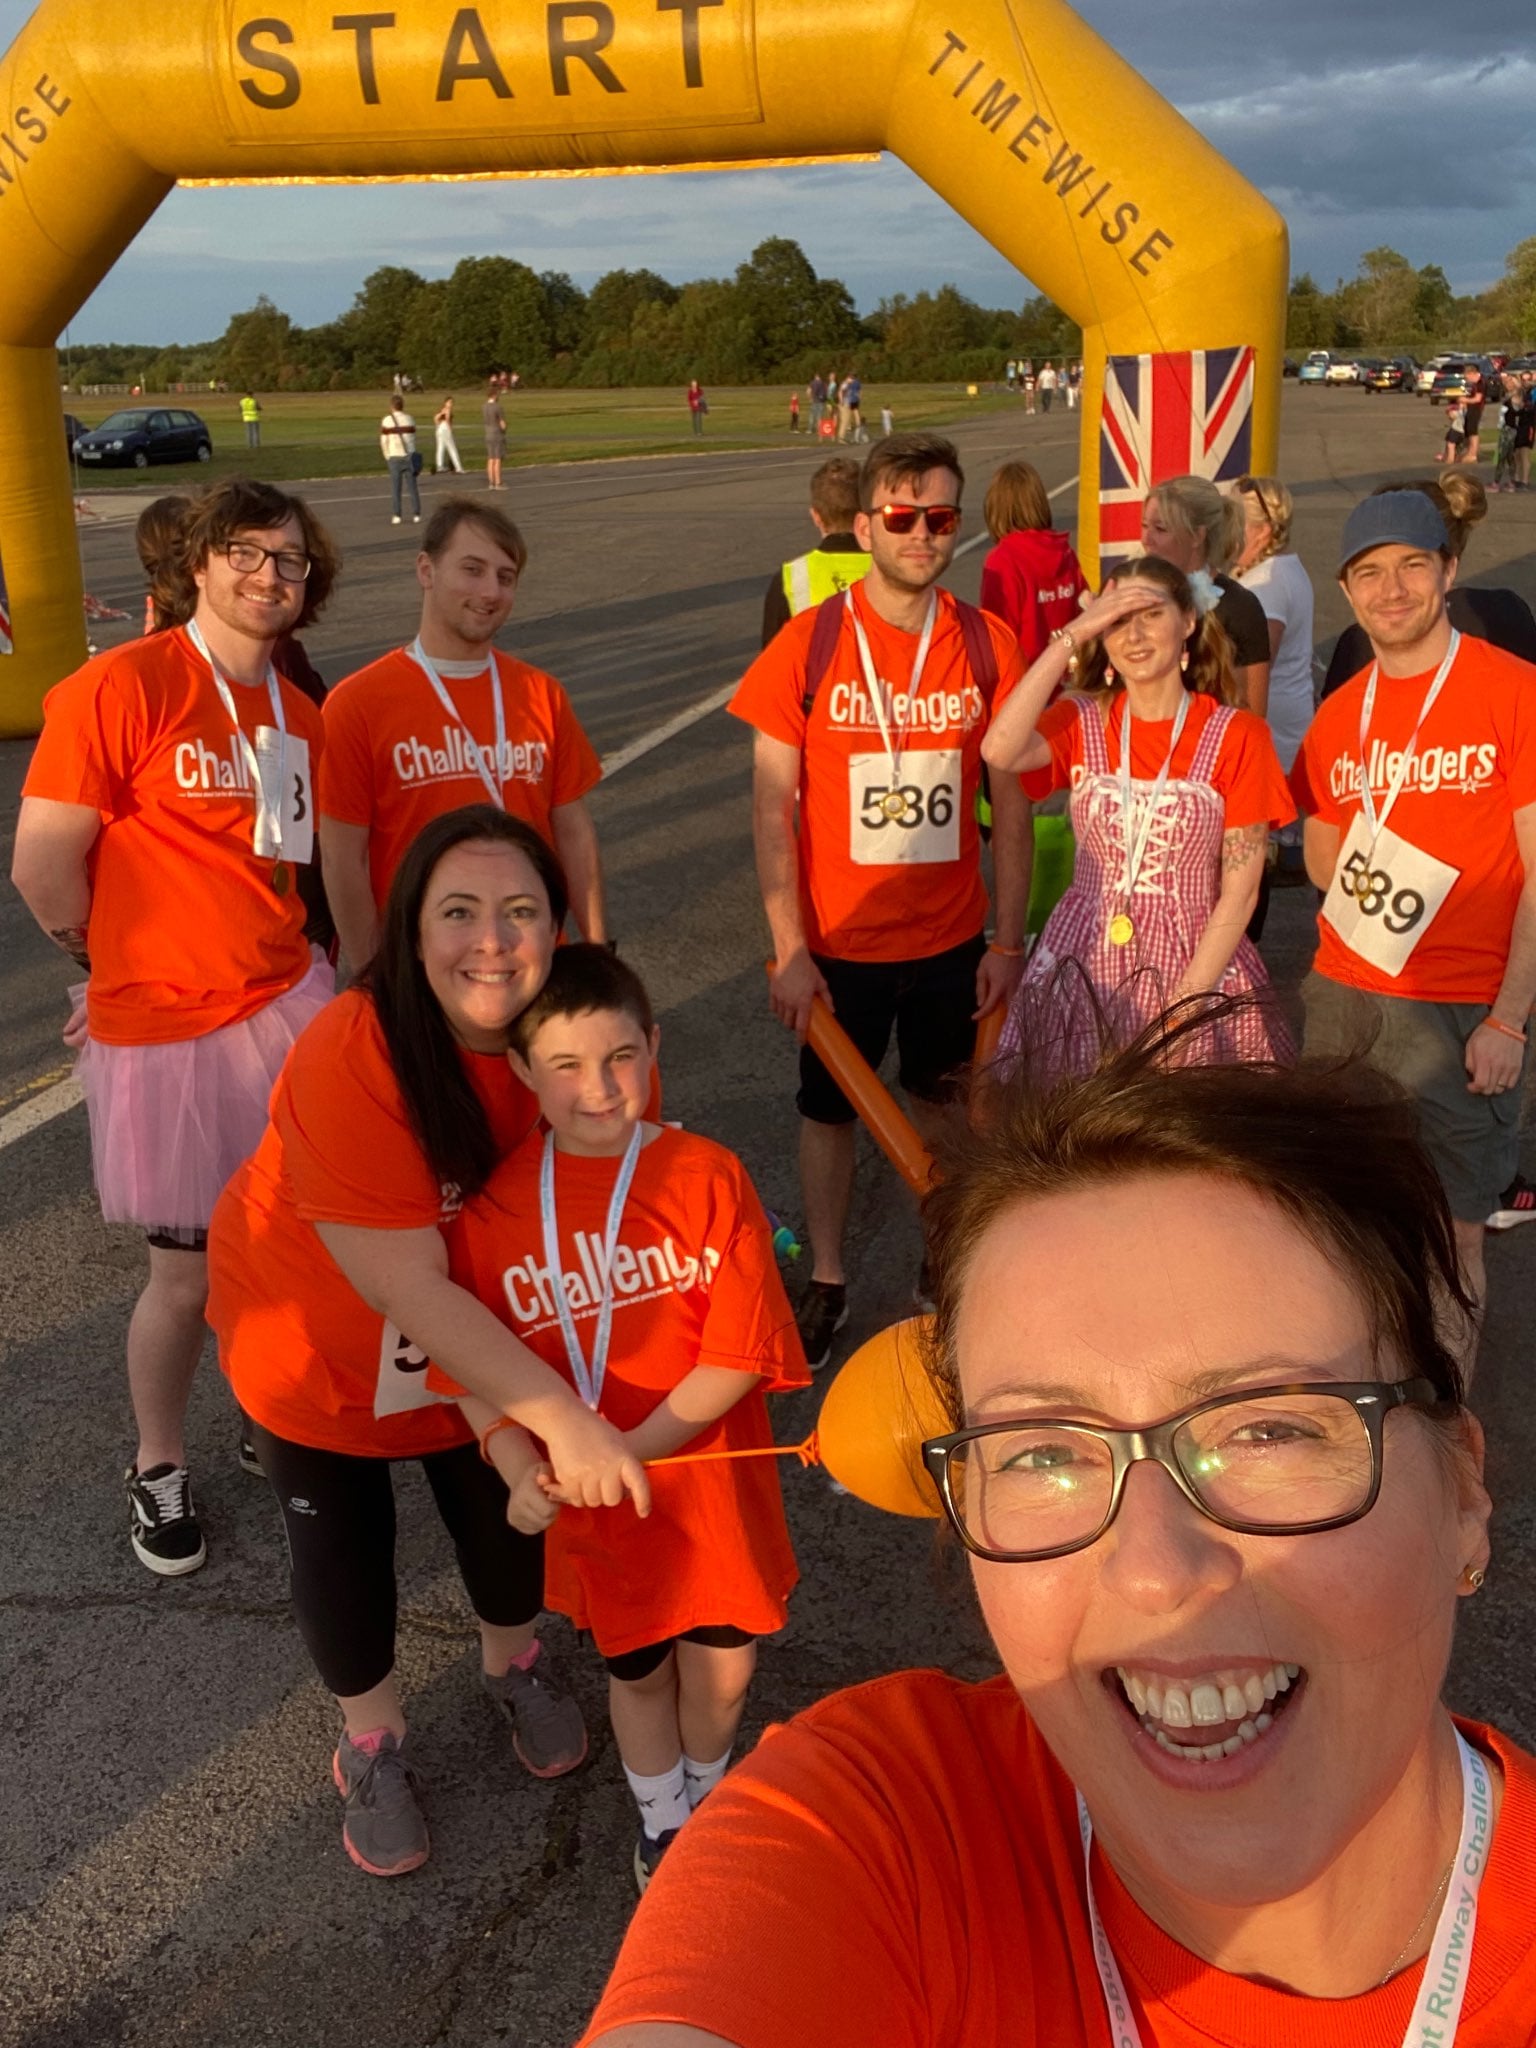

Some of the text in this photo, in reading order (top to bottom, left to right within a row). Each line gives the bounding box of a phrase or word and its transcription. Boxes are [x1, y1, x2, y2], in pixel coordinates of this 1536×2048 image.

[237, 0, 724, 110] START
[928, 29, 1175, 277] TIMEWISE
[1425, 1886, 1477, 2020] Runway
[1463, 1750, 1488, 1877] Challen
